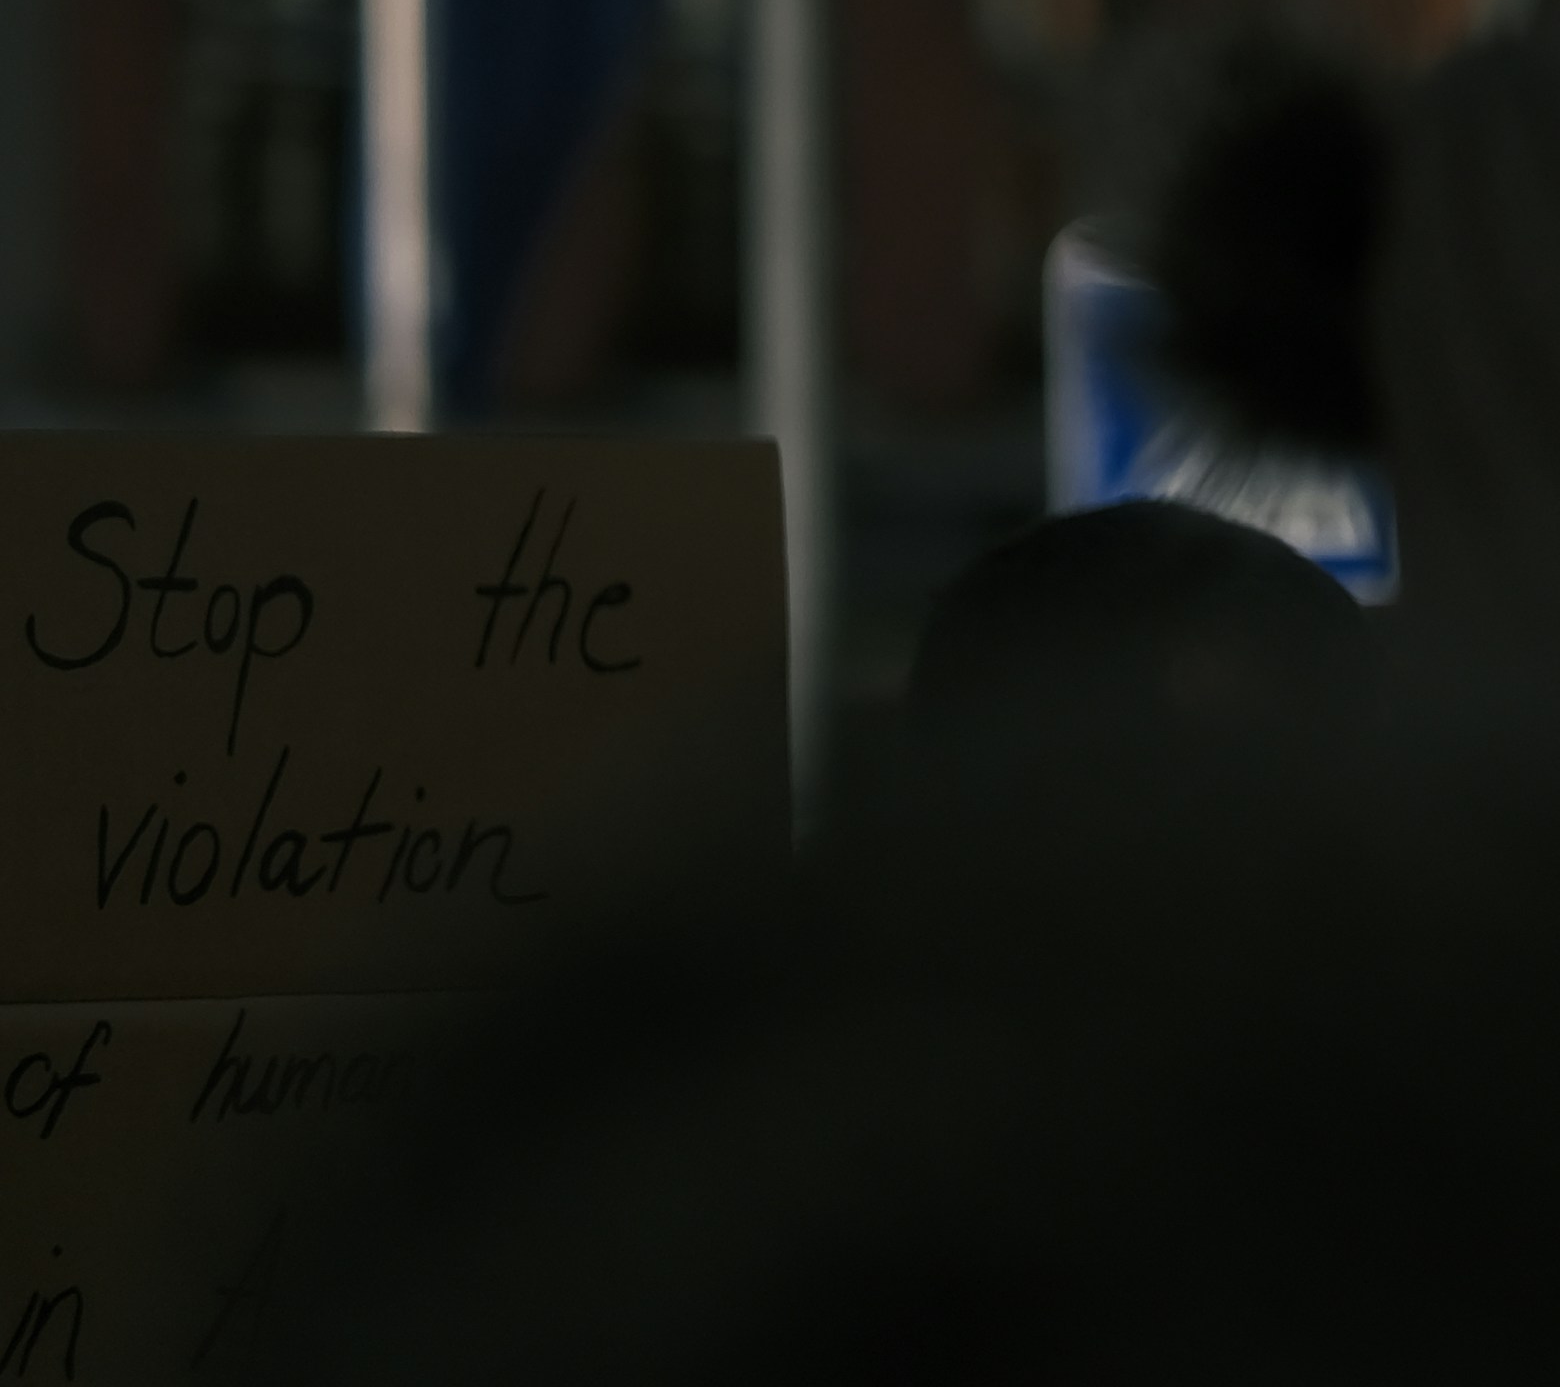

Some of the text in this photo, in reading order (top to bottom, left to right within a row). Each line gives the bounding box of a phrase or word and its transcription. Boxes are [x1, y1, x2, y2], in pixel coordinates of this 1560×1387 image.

[25, 487, 641, 756] Stop the
[98, 745, 548, 909] violation
[4, 1020, 111, 1139] of
[0, 1245, 83, 1381] in
